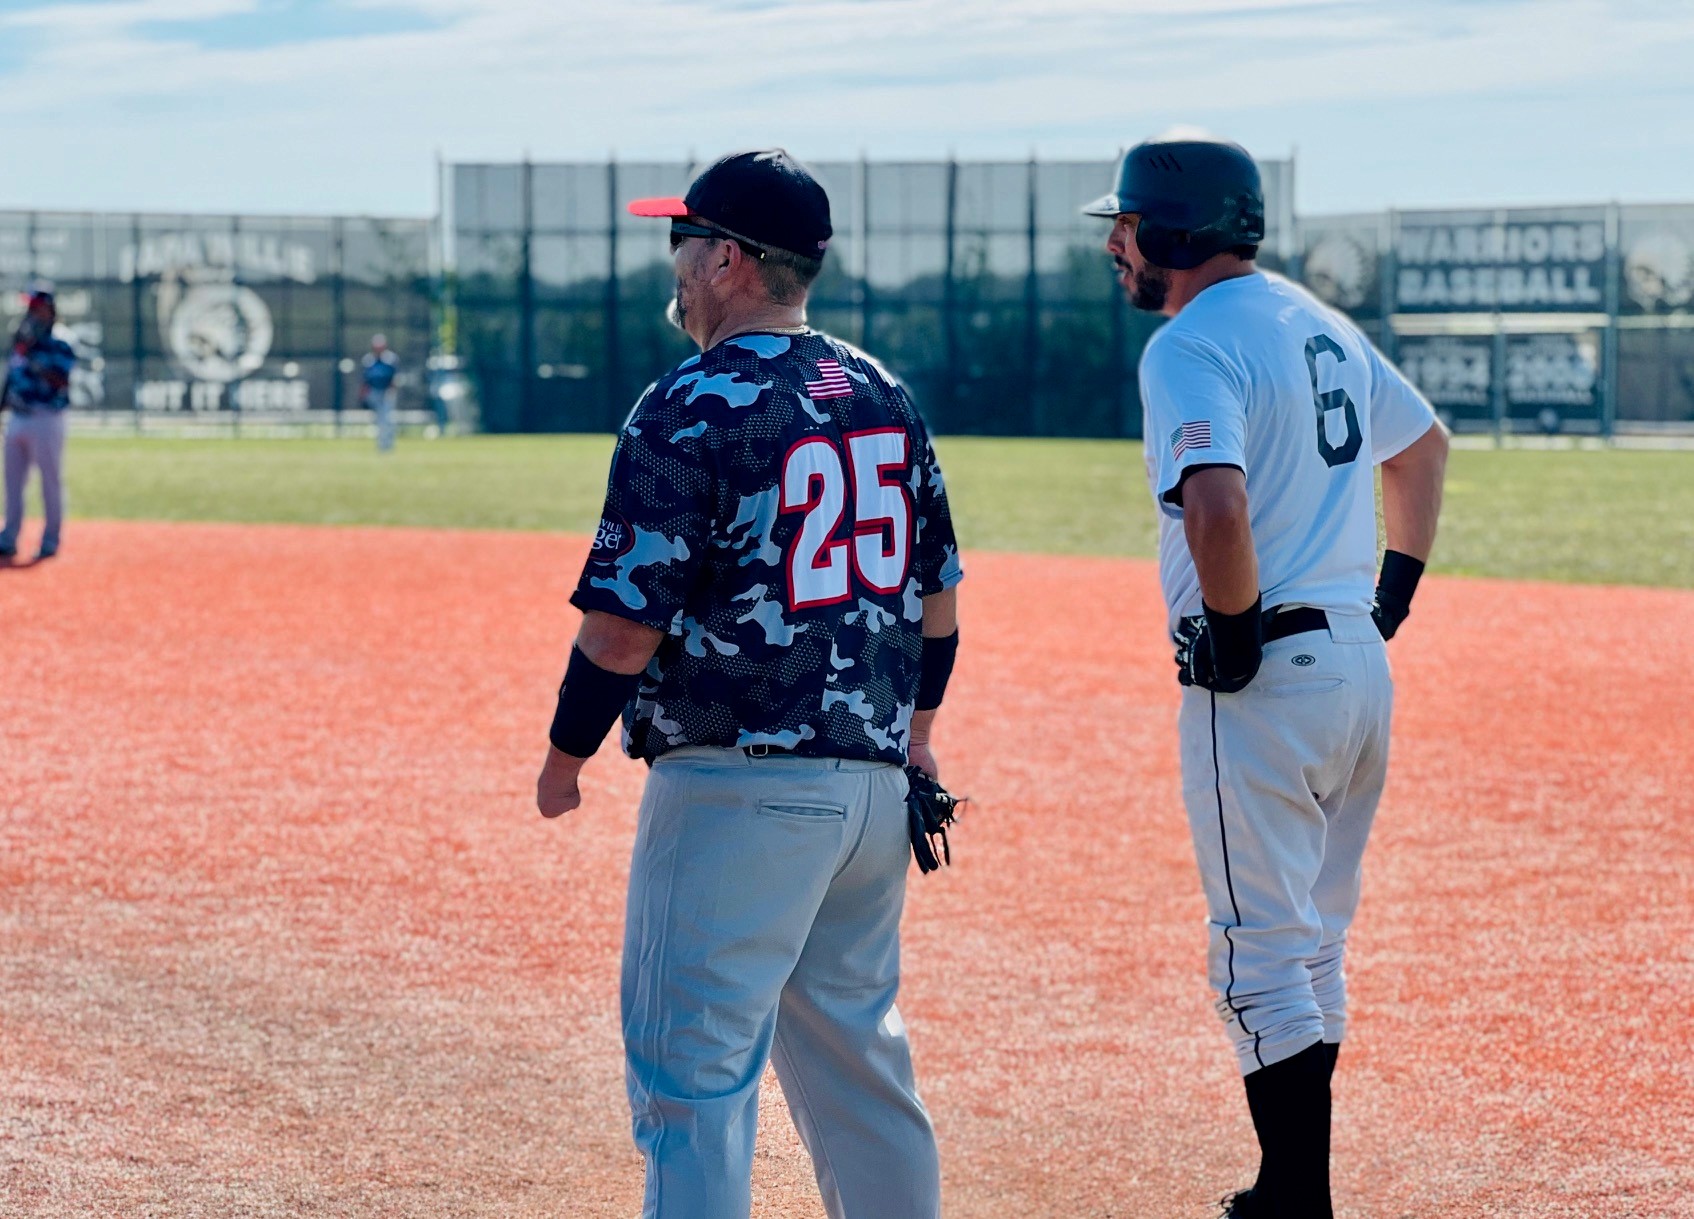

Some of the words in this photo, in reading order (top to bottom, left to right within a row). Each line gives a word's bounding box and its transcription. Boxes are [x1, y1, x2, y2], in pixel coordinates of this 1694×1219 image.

[1398, 224, 1604, 265] WARRIORS
[1398, 267, 1601, 305] BASEBALL
[1305, 333, 1363, 468] 6
[779, 426, 913, 613] 25
